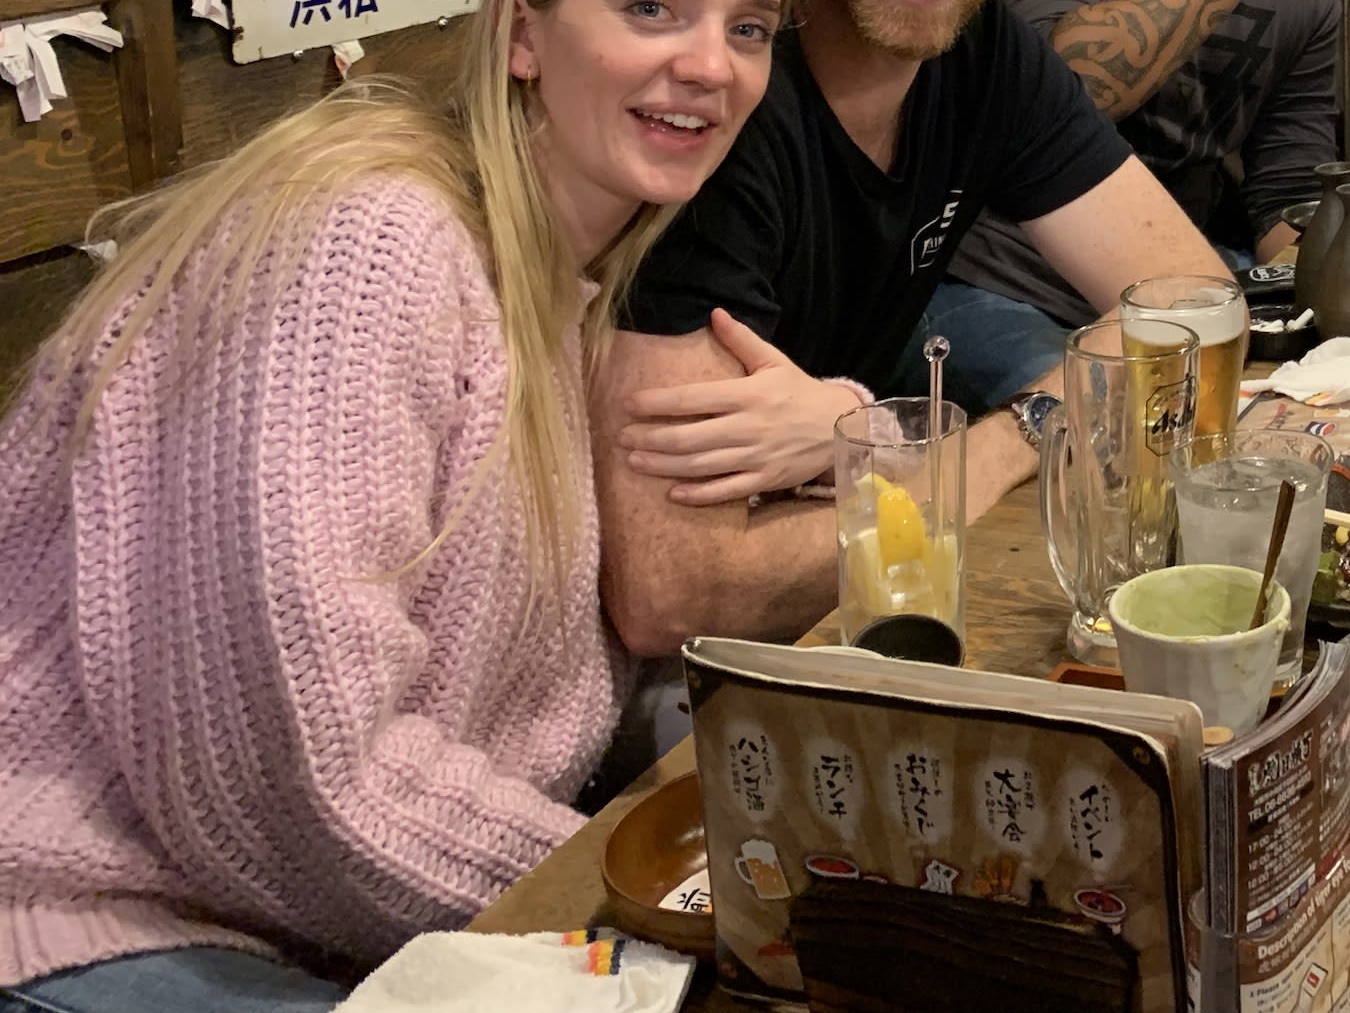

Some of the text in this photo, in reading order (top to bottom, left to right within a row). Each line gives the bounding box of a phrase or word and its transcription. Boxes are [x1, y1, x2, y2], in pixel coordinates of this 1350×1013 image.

[820, 755, 847, 819] ランチ
[906, 753, 935, 836] おみくじ
[1079, 784, 1104, 861] イベント
[1257, 912, 1307, 960] Description
